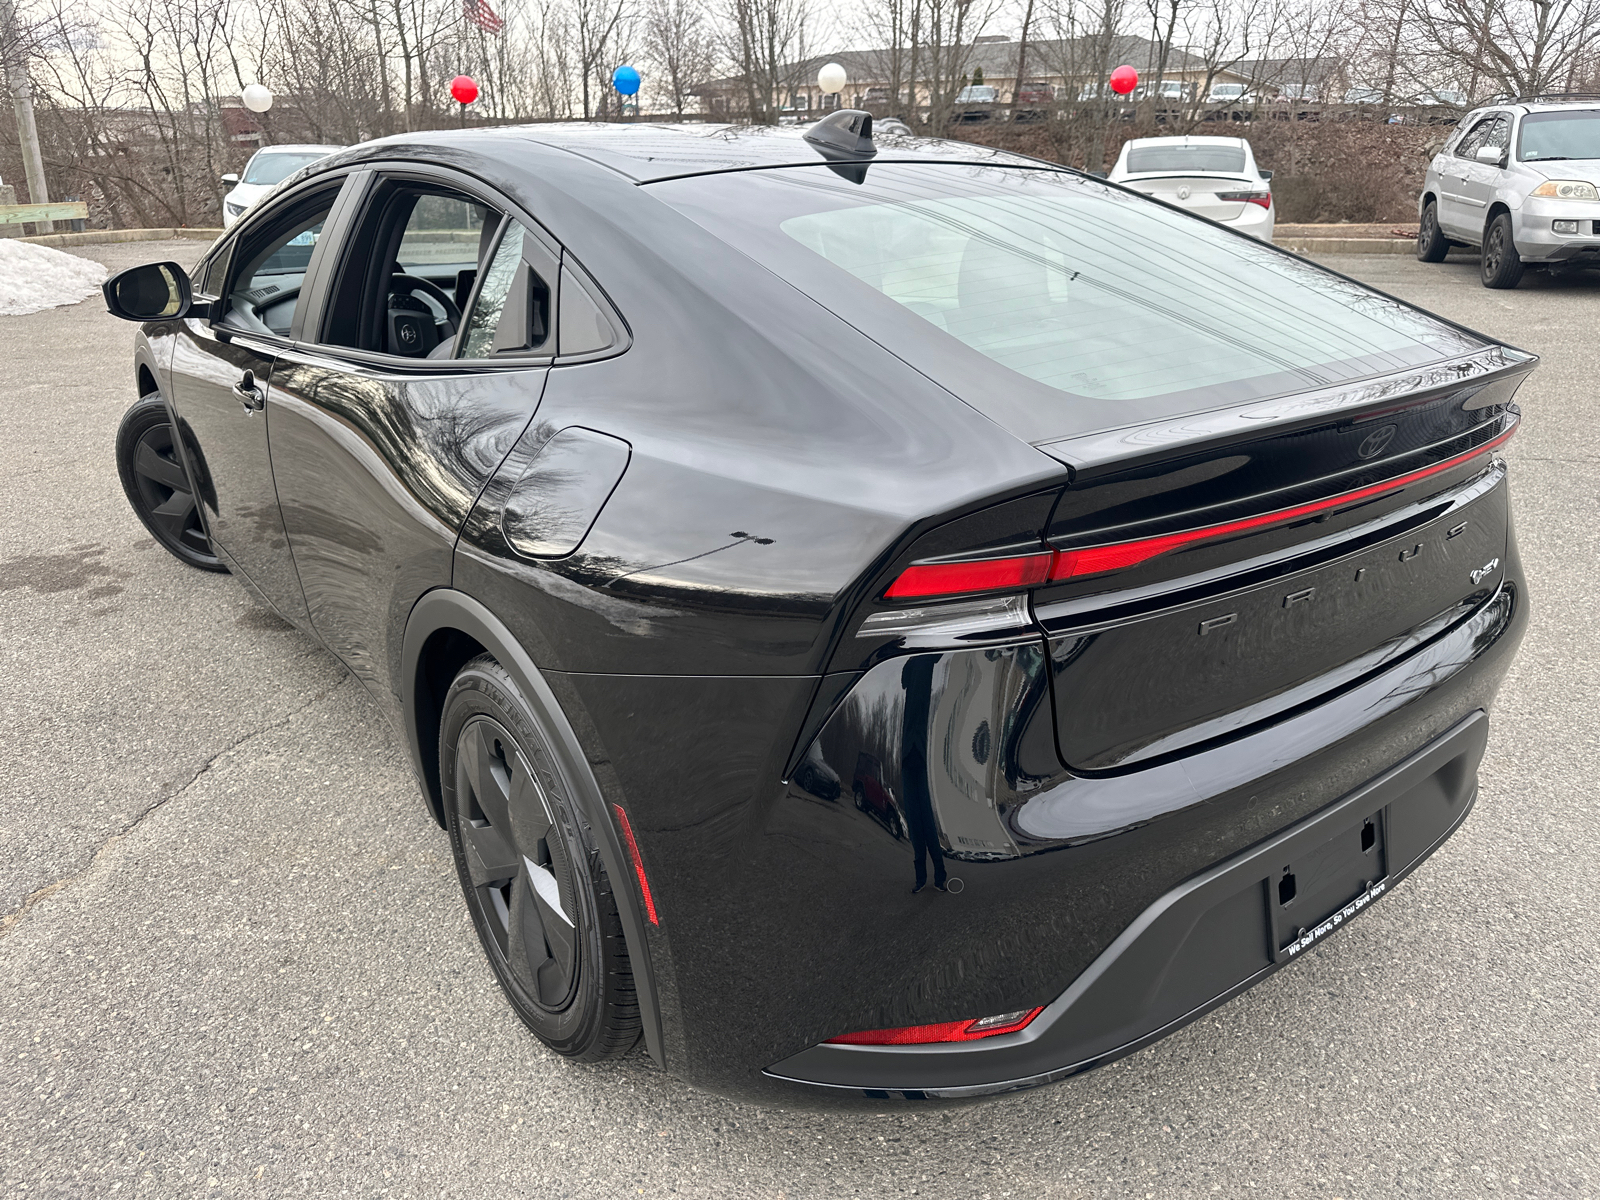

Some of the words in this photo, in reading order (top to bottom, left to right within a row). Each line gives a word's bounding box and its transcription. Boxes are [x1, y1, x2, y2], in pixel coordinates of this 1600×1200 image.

[1198, 520, 1468, 636] PRIUS
[1288, 944, 1301, 956] We
[1300, 934, 1314, 948] Sell
[1314, 921, 1334, 939] More,
[1333, 914, 1343, 926] So
[1342, 906, 1356, 918] You
[1355, 894, 1371, 910] Save
[1370, 883, 1386, 898] More
